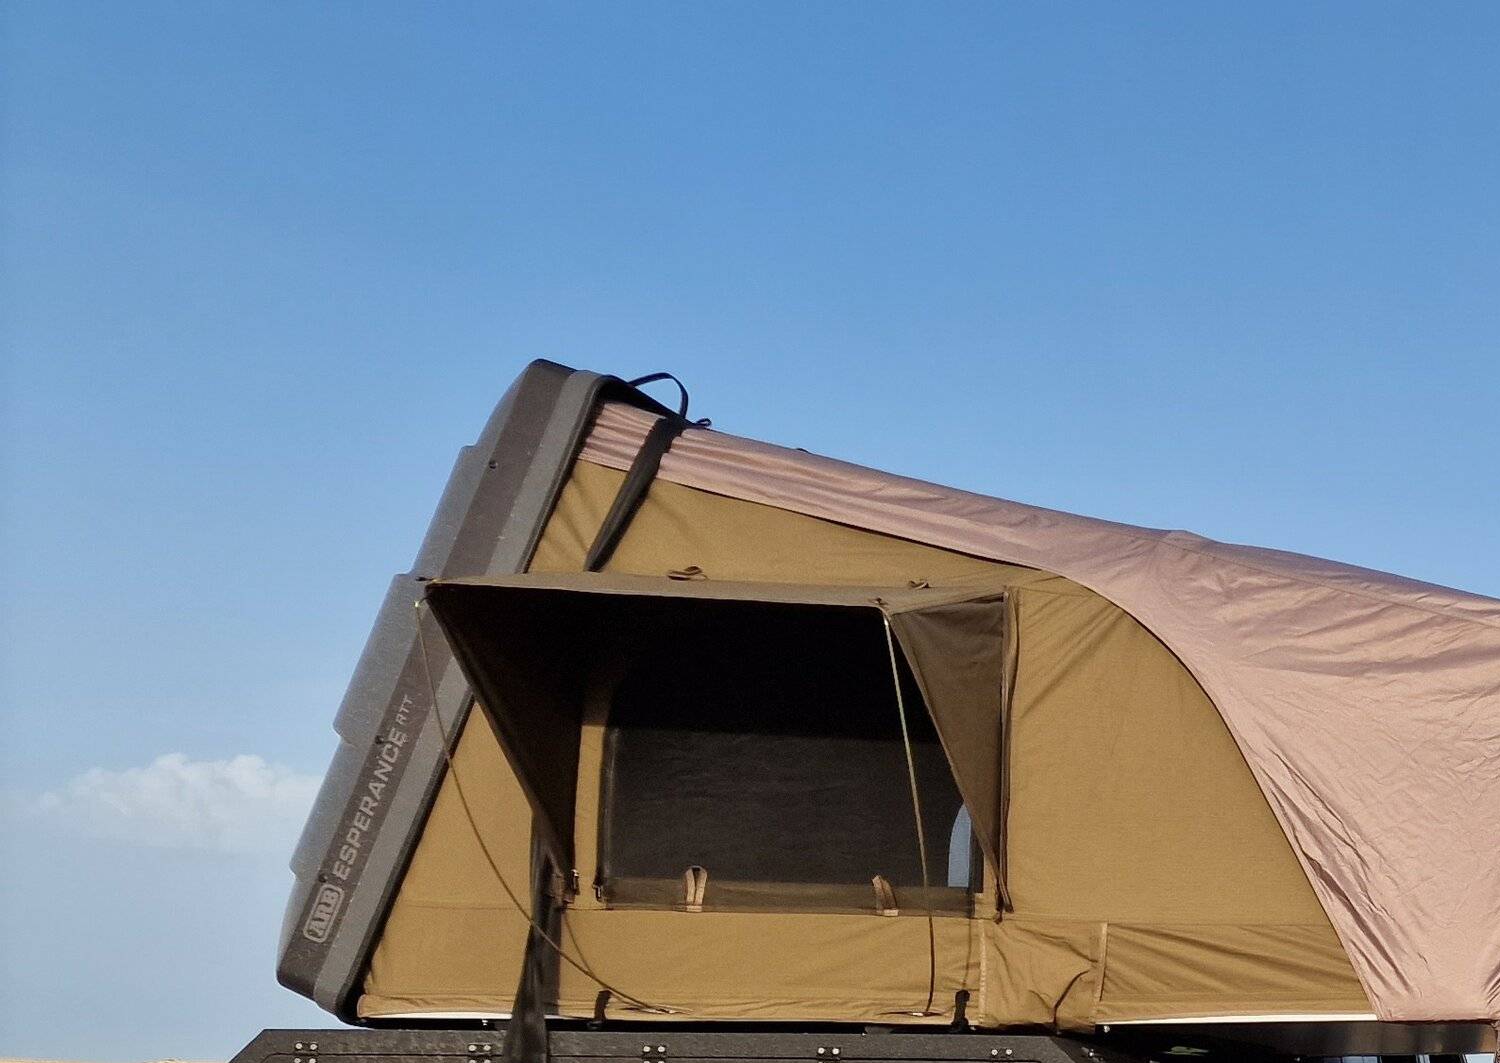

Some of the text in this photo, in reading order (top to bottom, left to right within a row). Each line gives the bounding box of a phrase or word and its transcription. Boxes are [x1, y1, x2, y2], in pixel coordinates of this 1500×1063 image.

[306, 694, 413, 940] ARB ESPERANCE RTT
